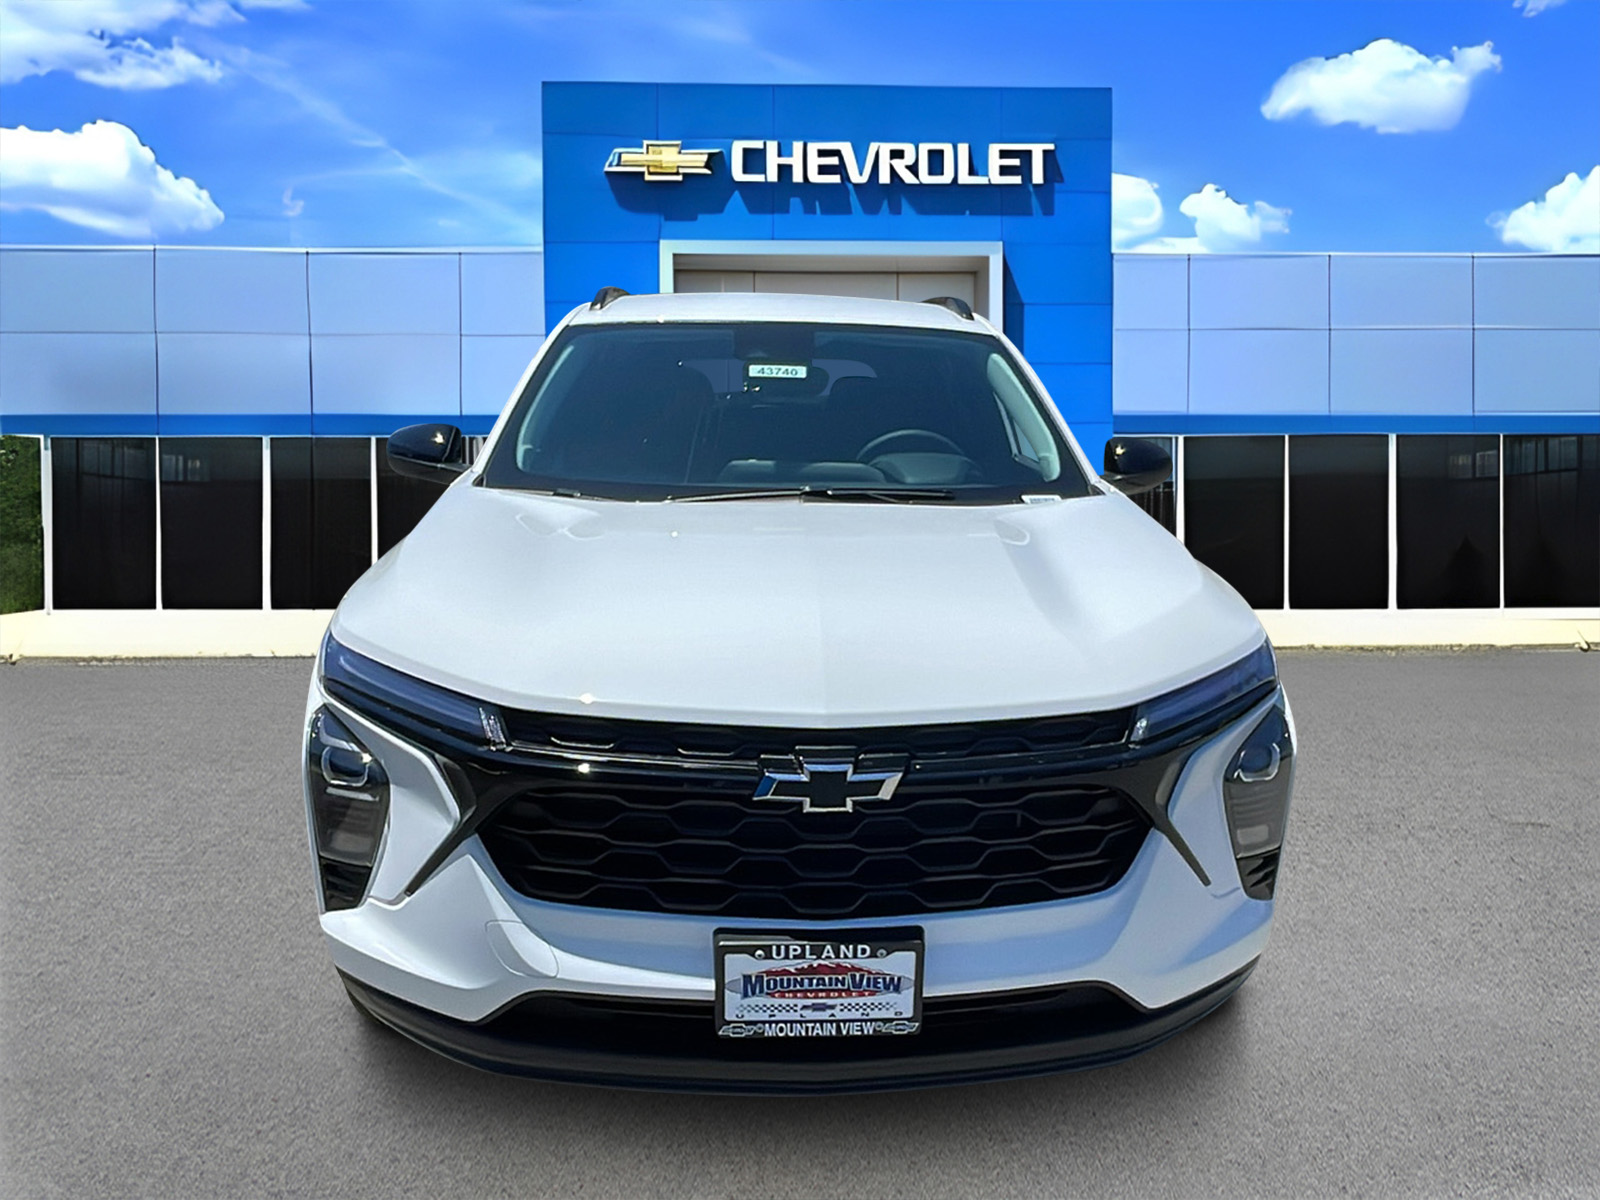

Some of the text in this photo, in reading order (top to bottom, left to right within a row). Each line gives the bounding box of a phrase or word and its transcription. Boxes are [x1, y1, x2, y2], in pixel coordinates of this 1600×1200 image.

[731, 140, 1056, 185] CHEVROLET
[757, 366, 798, 376] 43740
[771, 944, 871, 960] UPLAND
[741, 972, 902, 999] MOUNTAIN VIEW
[764, 1022, 837, 1037] MOUNTAIN
[840, 1021, 875, 1036] VIEW
